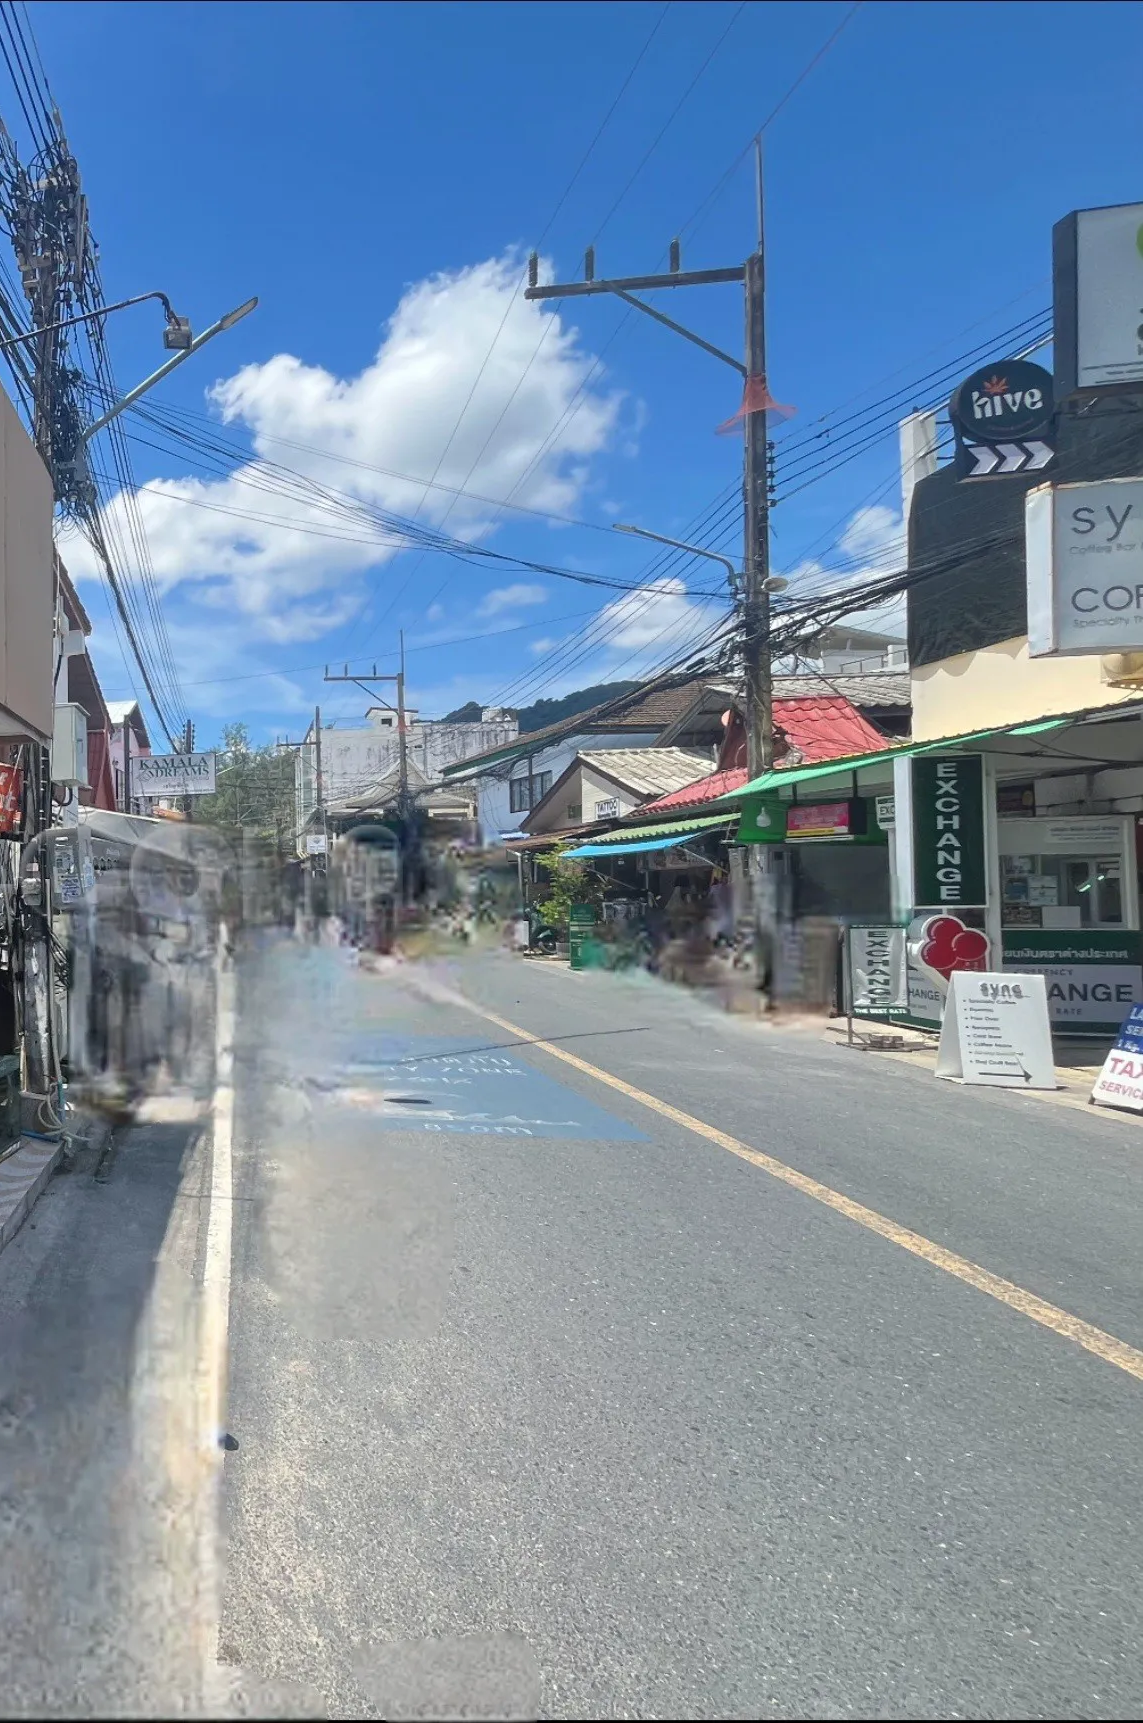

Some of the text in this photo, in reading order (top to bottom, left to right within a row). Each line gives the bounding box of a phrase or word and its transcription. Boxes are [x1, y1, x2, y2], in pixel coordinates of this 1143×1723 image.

[971, 388, 1044, 420] hive
[139, 756, 209, 770] KAMALA
[155, 767, 210, 778] DREAMS
[935, 762, 962, 901] EXCHANGE
[865, 930, 891, 1005] EXCHANGE
